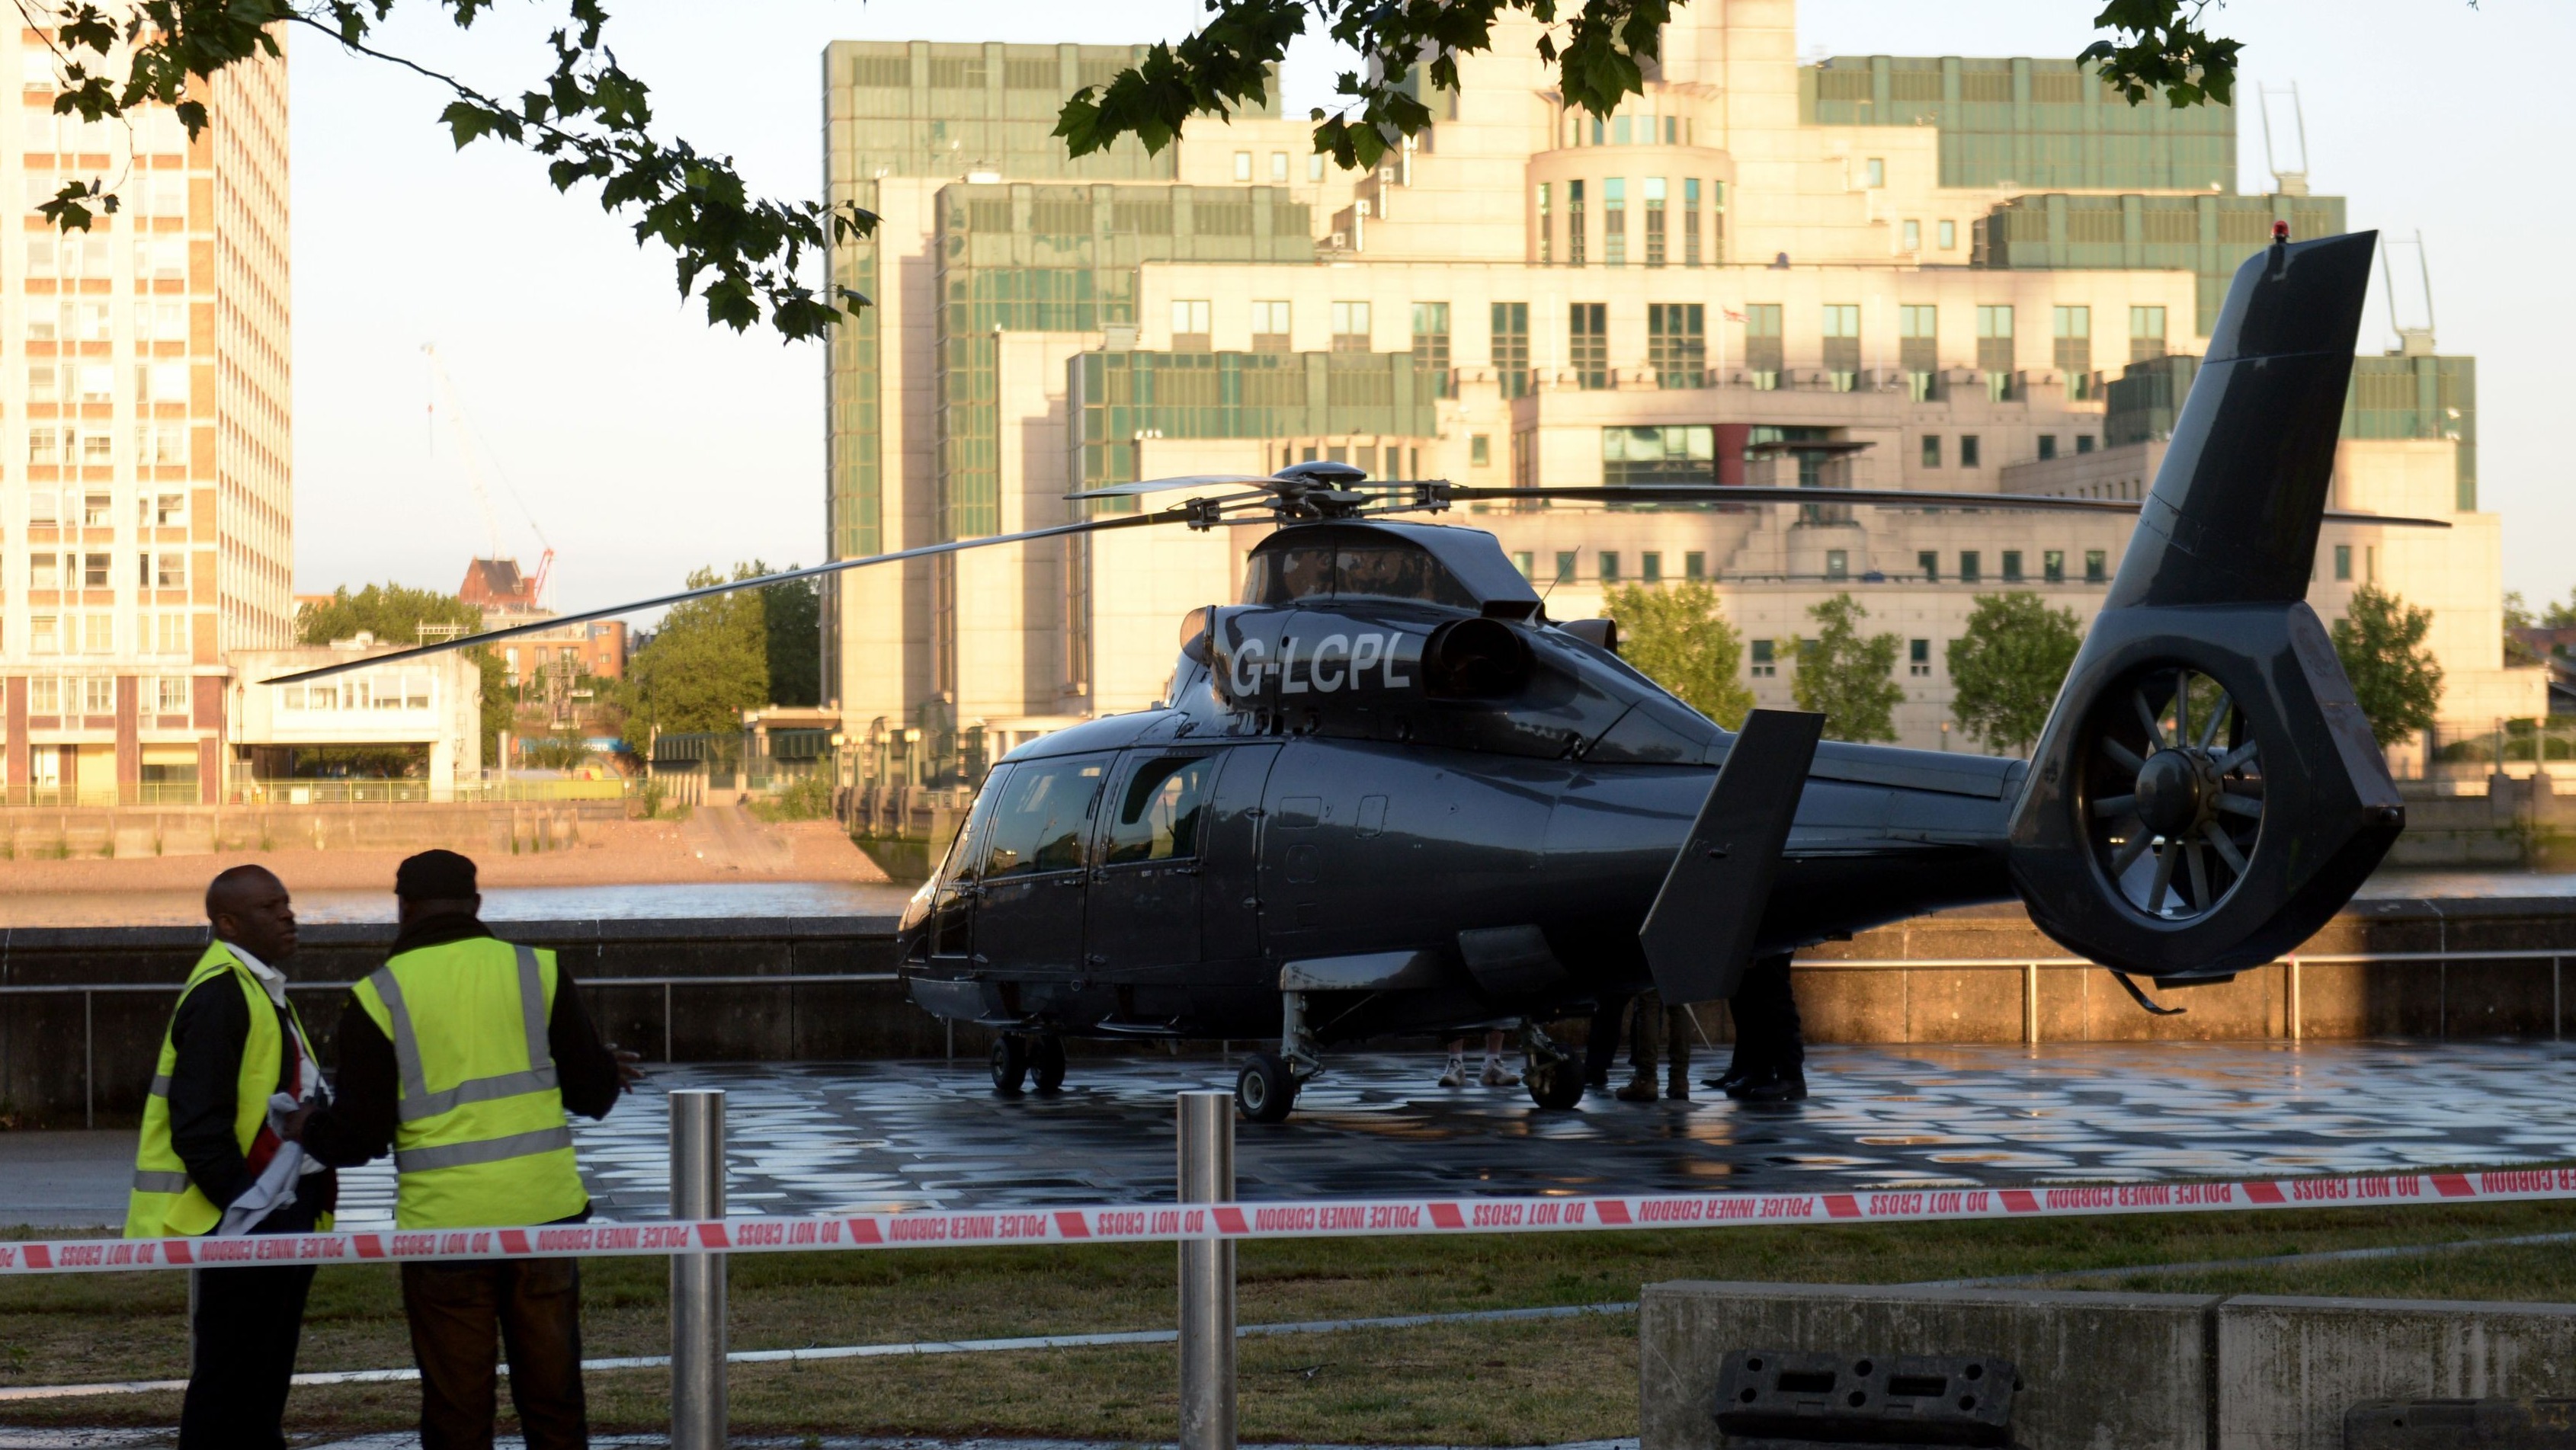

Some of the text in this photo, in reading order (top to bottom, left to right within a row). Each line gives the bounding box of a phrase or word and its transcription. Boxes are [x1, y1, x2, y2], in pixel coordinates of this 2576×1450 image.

[1231, 632, 1410, 696] G-LCPL
[2293, 1176, 2419, 1200] DO NOT CROSS
[2482, 1170, 2553, 1192] CORDON
[1870, 1191, 1988, 1215] DO NOT CROSS
[2047, 1185, 2232, 1208] POLICE INNER CORDON
[1256, 1205, 1420, 1230] POLICE INNER CORDON
[1474, 1202, 1585, 1226] DO NOT CROSS
[1639, 1197, 1813, 1221] POLICE INNER CORDON
[738, 1221, 841, 1245] DO NOT CROSS
[889, 1215, 1047, 1240] POLICE INNER CORDON
[1098, 1209, 1204, 1234] DO NOT CROSS
[597, 1228, 639, 1249] INNER
[642, 1226, 689, 1248] POLICE
